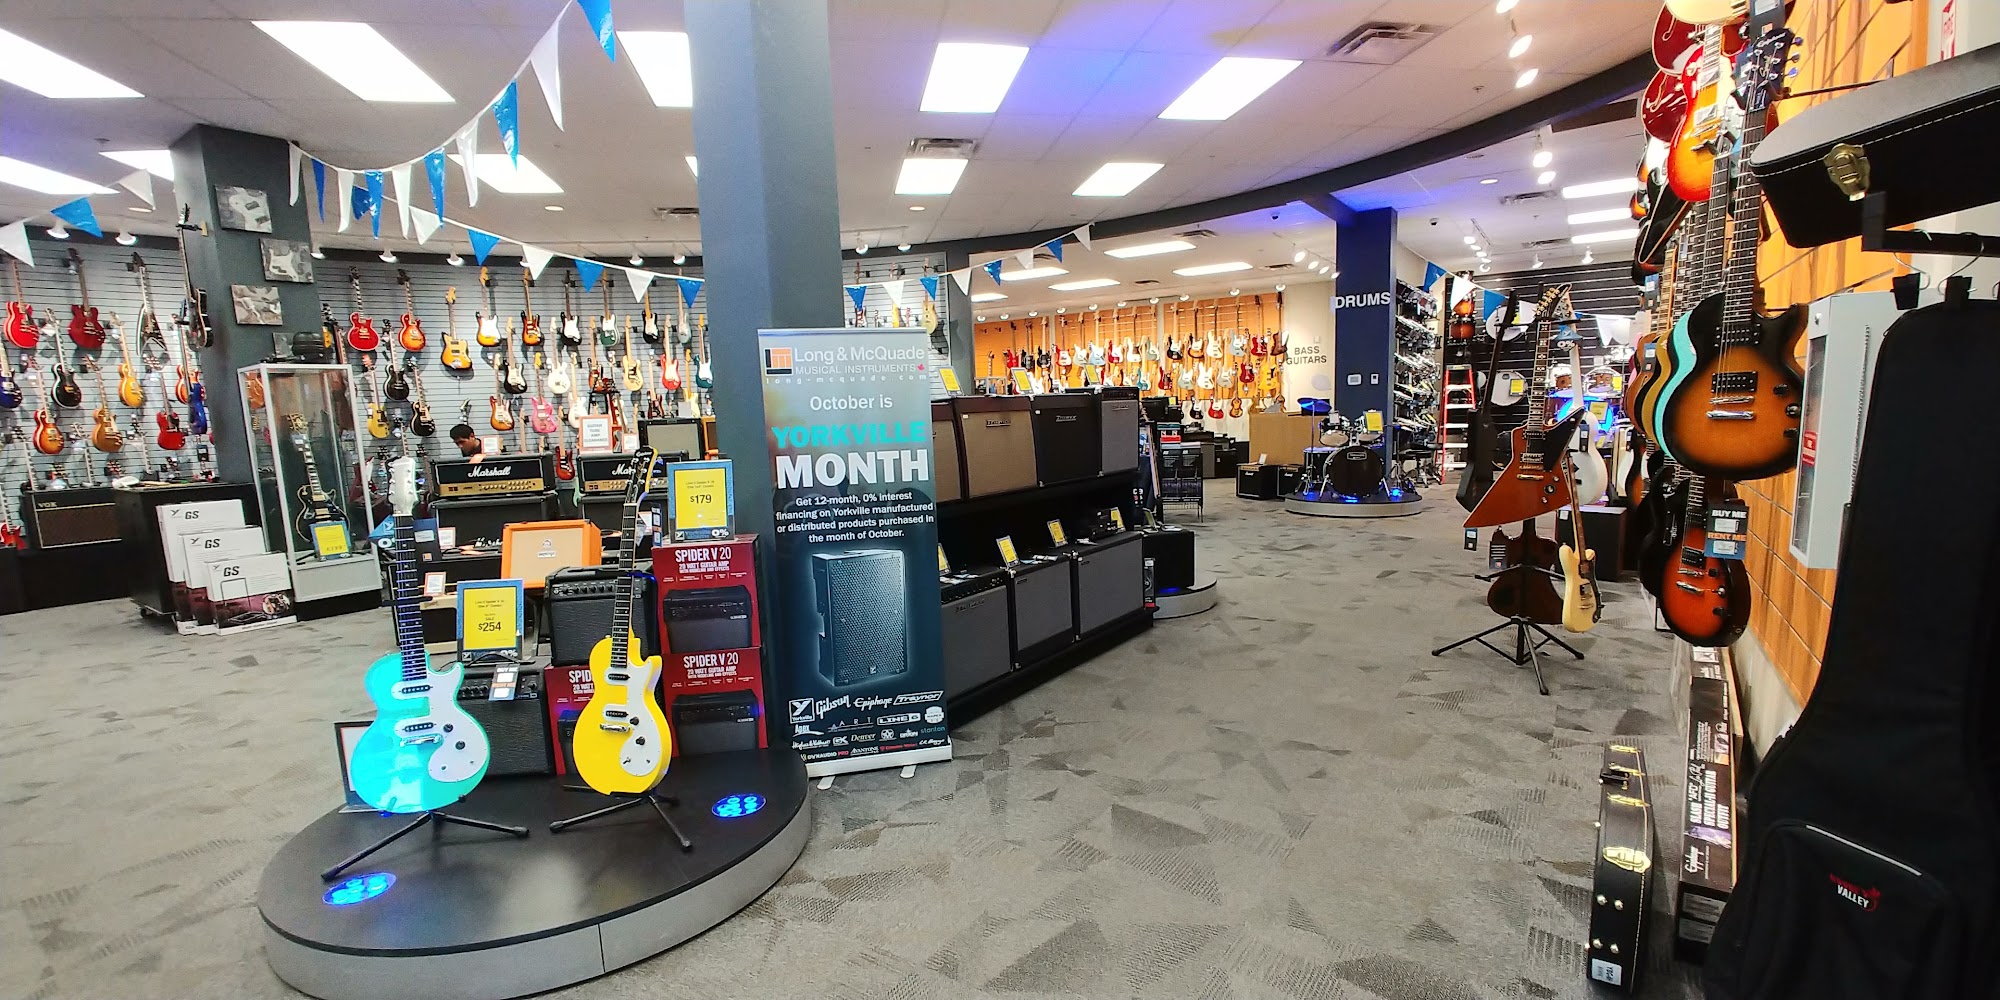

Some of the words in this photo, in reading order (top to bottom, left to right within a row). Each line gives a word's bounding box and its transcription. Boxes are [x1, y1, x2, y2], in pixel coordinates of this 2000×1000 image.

[1334, 292, 1390, 309] DRUMS
[794, 347, 834, 364] Long
[836, 346, 848, 362] &
[850, 346, 926, 362] McQuade
[1294, 346, 1320, 356] BASS
[1286, 355, 1327, 365] GUITARS
[796, 366, 842, 375] MUSICAL
[844, 364, 916, 374] INSTRUMENTS
[810, 395, 875, 410] October
[880, 394, 893, 408] is
[771, 421, 926, 449] YORKVILLE
[468, 465, 512, 478] Marshall
[775, 449, 929, 489] MONTH
[690, 494, 712, 504] $179
[796, 498, 812, 506] Get
[814, 494, 861, 506] 12-month,
[862, 494, 878, 503] 0%
[879, 491, 912, 501] interest
[185, 510, 199, 520] GS
[776, 510, 818, 520] financing
[819, 509, 831, 518] on
[832, 506, 870, 517] Yorkville
[872, 503, 934, 514] manufactured
[788, 520, 836, 532] distributed
[838, 518, 877, 530] products
[878, 515, 924, 527] purchased
[926, 514, 934, 523] in
[712, 528, 729, 538] 0%
[808, 534, 824, 543] the
[826, 532, 856, 542] month
[857, 531, 867, 540] of
[868, 529, 904, 539] October.
[204, 539, 220, 549] GS
[675, 548, 710, 563] SPIDER
[711, 548, 718, 560] V
[720, 547, 732, 559] 20
[223, 566, 240, 576] GS
[478, 622, 501, 632] $254
[683, 654, 718, 668] SPIDER
[718, 653, 725, 666] V
[727, 652, 738, 665] 20
[569, 670, 592, 683] SPID
[816, 695, 851, 720] Gibson
[853, 695, 893, 711] Epiphone
[898, 693, 940, 703] Traynor
[851, 734, 876, 742] Denver
[921, 726, 945, 734] stanton
[1704, 770, 1717, 792] GUITAR
[1690, 802, 1702, 824] SLASH
[1703, 792, 1716, 826] SPECIAL-II
[1717, 804, 1729, 829] OUTFIT
[1684, 846, 1704, 873] Epiphone
[1837, 884, 1869, 908] VALLEY
